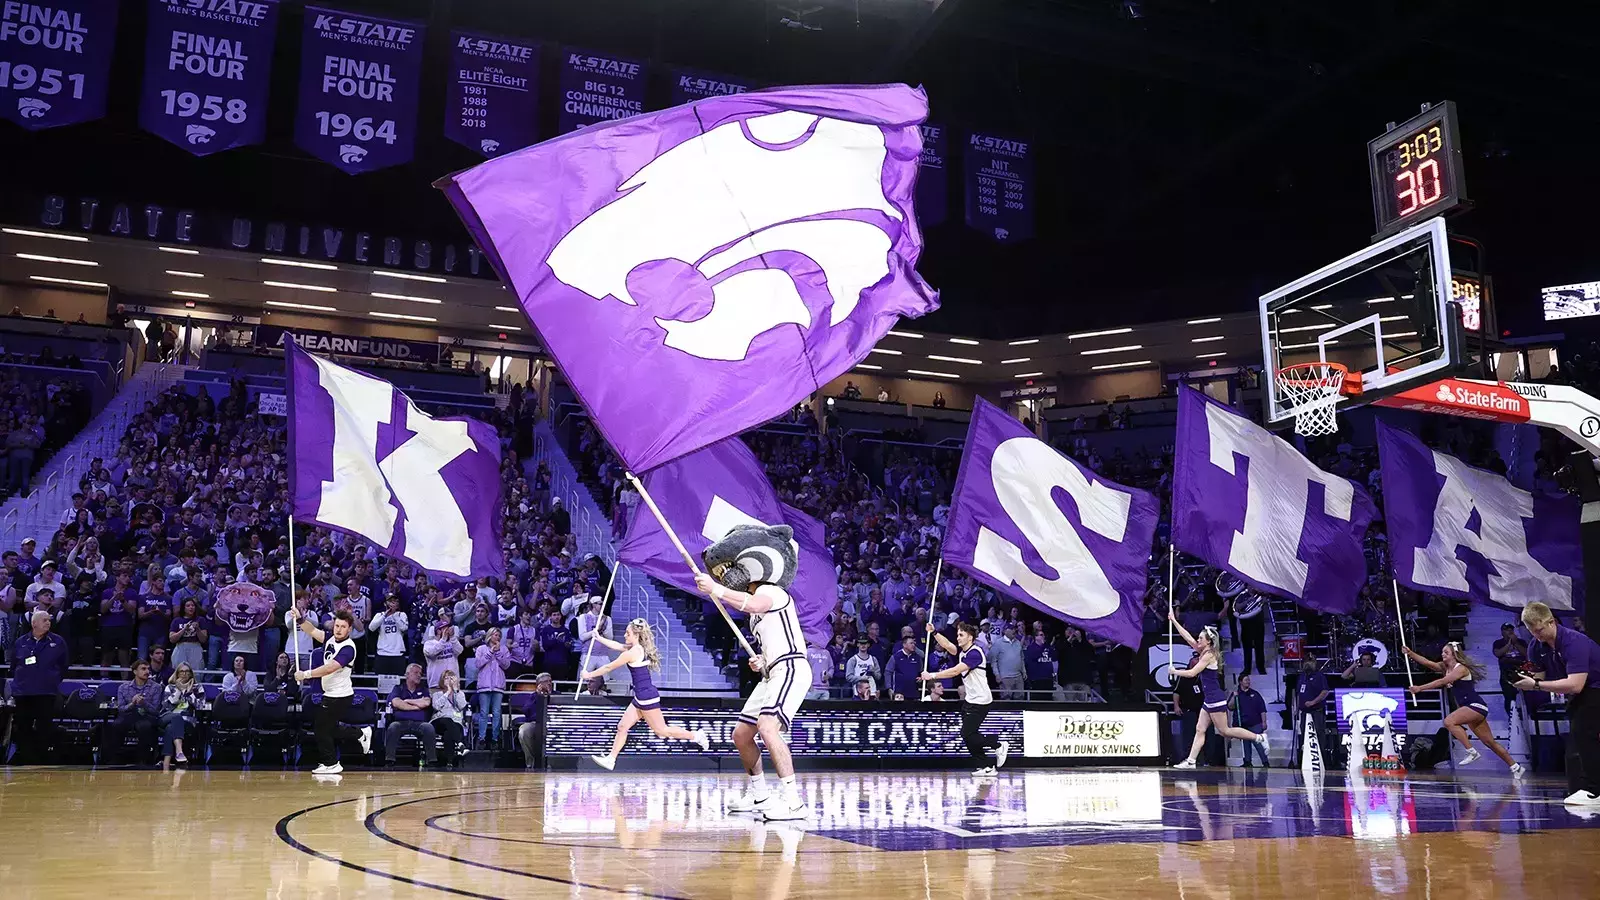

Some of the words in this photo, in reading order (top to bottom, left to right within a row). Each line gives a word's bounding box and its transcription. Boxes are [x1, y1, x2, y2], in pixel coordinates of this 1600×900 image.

[3, 0, 88, 34] FINAL
[160, 0, 269, 20] STATE
[167, 5, 196, 16] MEN'S
[199, 10, 259, 27] BASKETBALL
[0, 21, 84, 54] FOUR
[313, 14, 415, 44] K-STATE
[171, 30, 248, 61] FINAL
[320, 31, 348, 41] MEN'S
[350, 35, 406, 51] BASKETBALL
[457, 36, 533, 59] K-STATE
[168, 51, 245, 81] FOUR
[462, 48, 483, 57] MEN'S
[484, 50, 526, 64] BASKETBALL
[568, 53, 640, 75] K-STATE
[324, 55, 396, 83] FINAL
[459, 69, 490, 82] ELITE
[492, 74, 528, 88] EIGHT
[0, 61, 85, 99] 1951
[322, 74, 393, 102] FOUR
[584, 80, 607, 94] BIG
[609, 85, 625, 97] 12
[679, 75, 747, 94] K-STATE
[463, 85, 487, 96] 1981
[566, 90, 642, 111] CONFERENCE
[160, 89, 247, 124] 1958
[462, 96, 488, 107] 1988
[461, 107, 487, 118] 2010
[315, 111, 397, 145] 1964
[460, 118, 487, 129] 2018
[970, 133, 1028, 154] K-STATE
[1399, 126, 1443, 169] 3:03
[981, 167, 1020, 179] APPEARANCES
[991, 159, 1010, 171] NIT
[978, 176, 997, 187] 1976
[1005, 181, 1023, 191] 1999
[978, 186, 997, 196] 1992
[1004, 191, 1023, 201] 2007
[1396, 159, 1442, 216] 30
[978, 196, 997, 206] 1994
[1004, 200, 1024, 210] 2009
[978, 205, 998, 216] 1998
[41, 195, 194, 242] STATE
[231, 217, 484, 275] UNIVERSIT
[231, 314, 244, 324] 20
[384, 625, 397, 634] 20
[989, 626, 1001, 635] 23
[802, 722, 860, 744] THE
[867, 722, 941, 745] CATS
[1058, 715, 1124, 740] Briggs
[1043, 744, 1071, 754] SLAM
[1074, 744, 1099, 754] DUNK
[1101, 744, 1141, 754] SAVINGS
